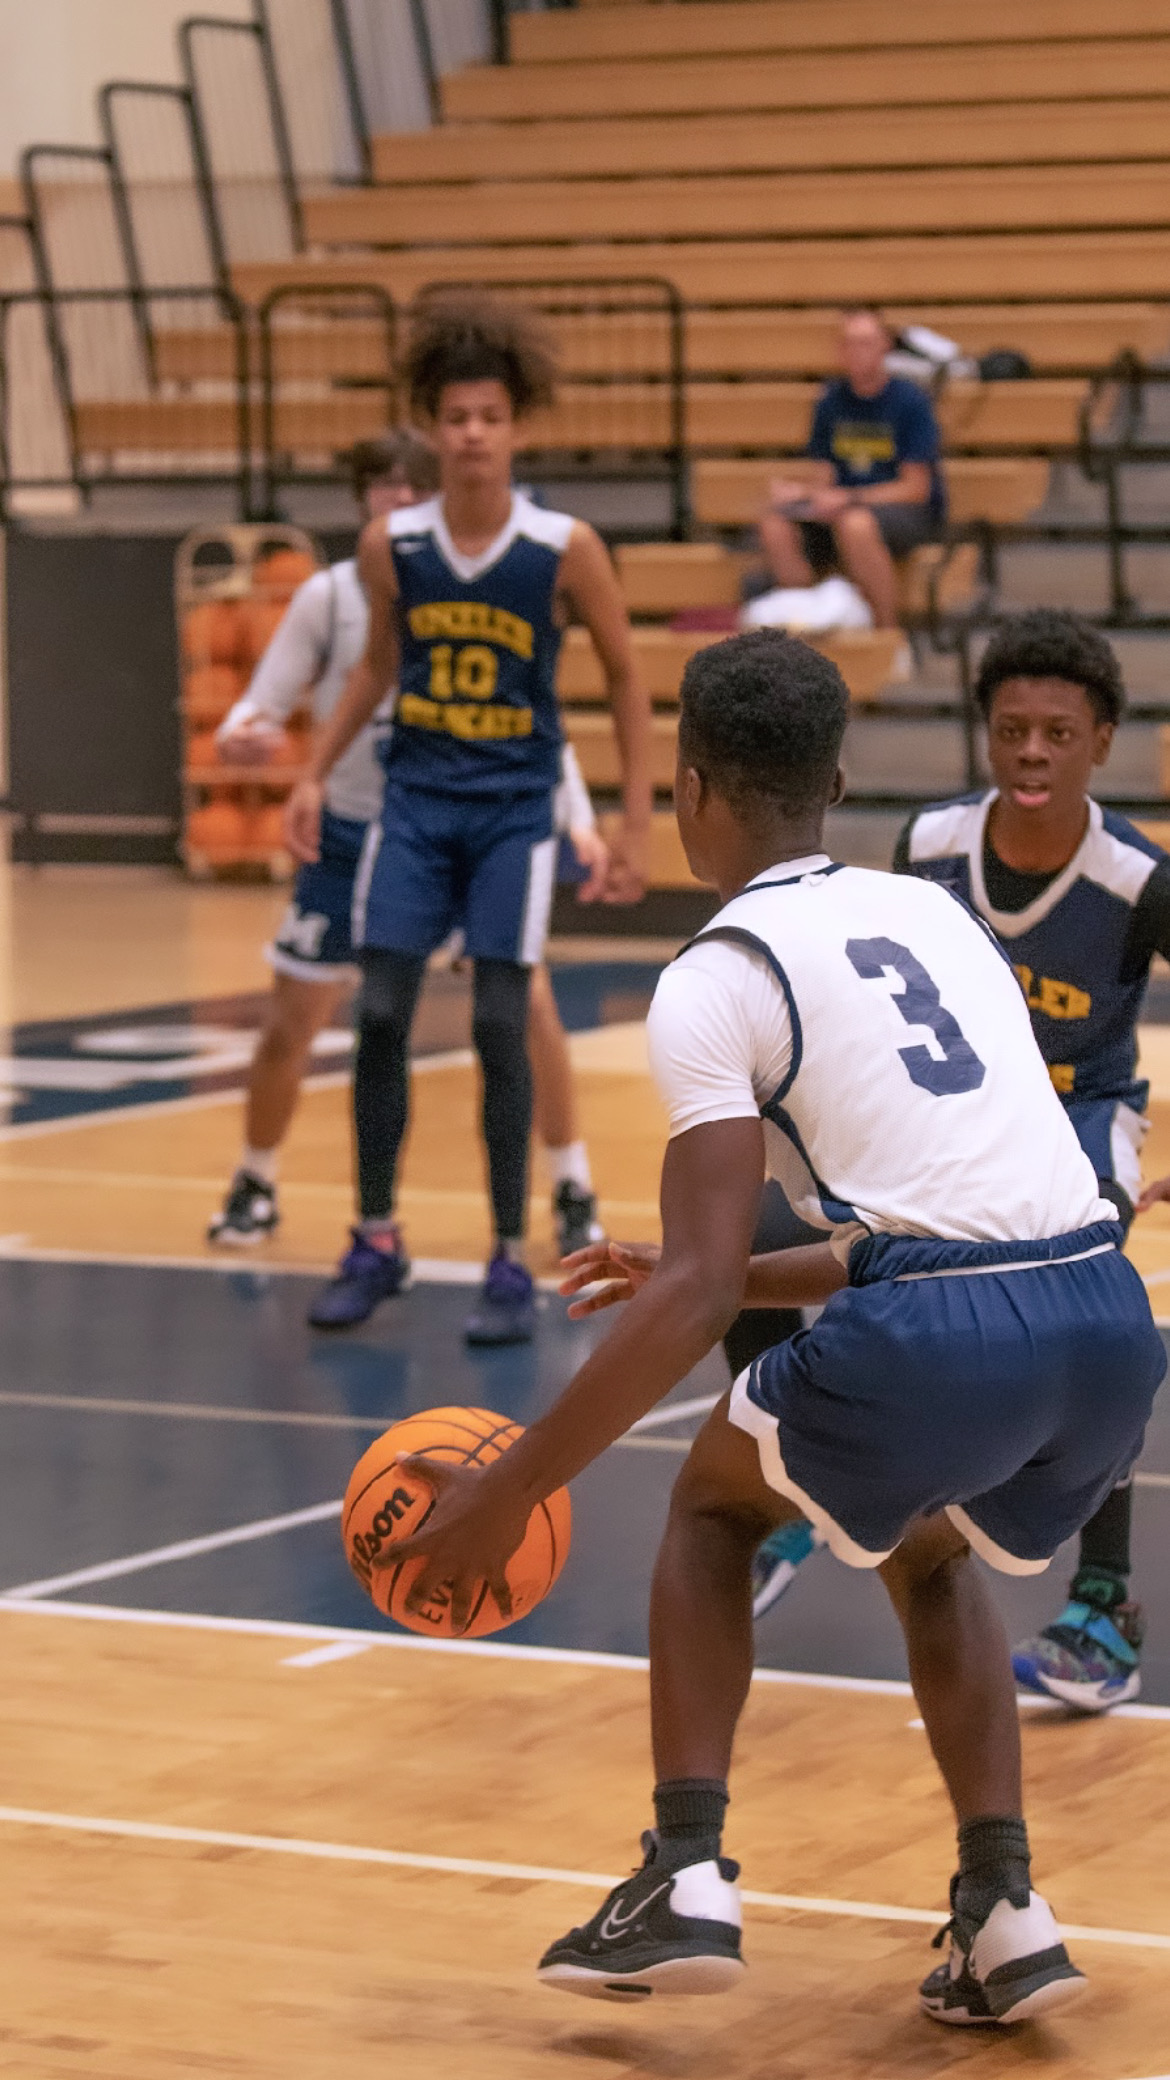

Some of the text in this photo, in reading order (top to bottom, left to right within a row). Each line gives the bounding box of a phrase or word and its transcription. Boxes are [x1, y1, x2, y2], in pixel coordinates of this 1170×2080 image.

[429, 644, 498, 700] 10
[845, 936, 987, 1097] 3
[418, 1578, 455, 1625] EV
